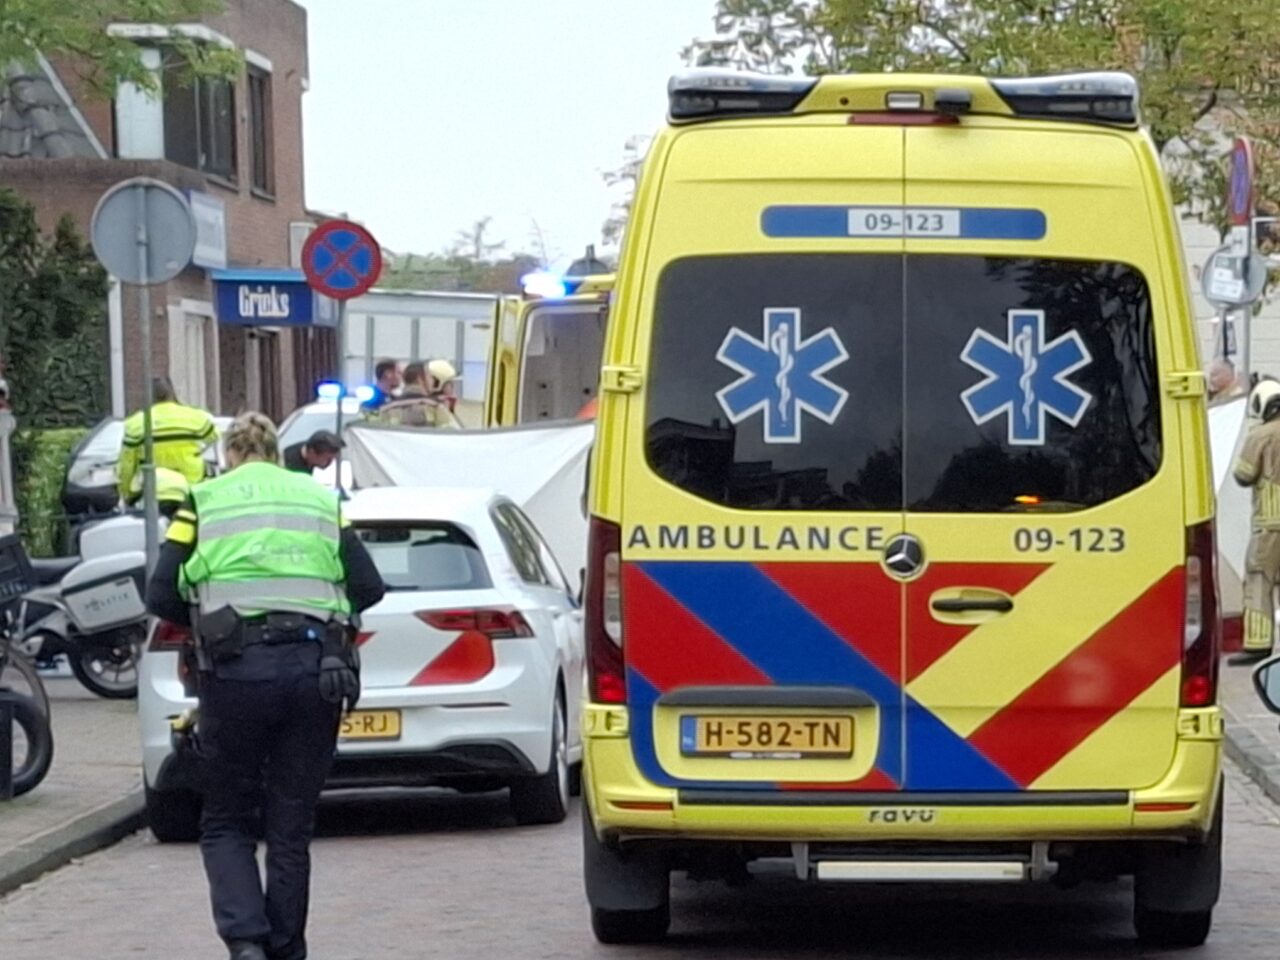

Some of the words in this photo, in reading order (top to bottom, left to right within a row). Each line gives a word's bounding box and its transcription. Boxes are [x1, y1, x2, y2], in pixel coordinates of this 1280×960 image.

[864, 213, 944, 231] 09-123
[627, 524, 885, 551] AMBULANCE
[1014, 527, 1125, 553] 09-123
[705, 721, 841, 747] H-582-TN
